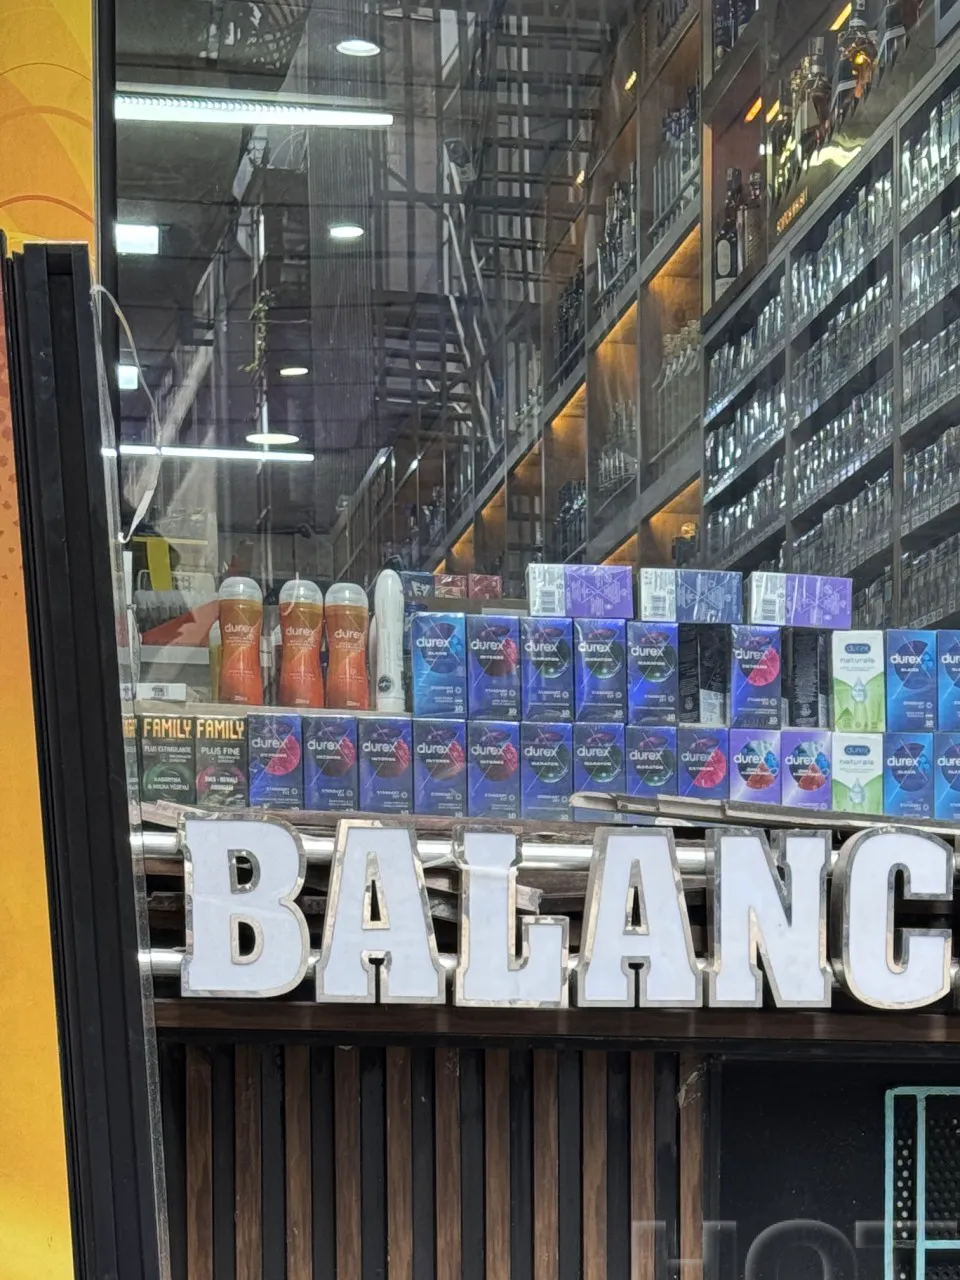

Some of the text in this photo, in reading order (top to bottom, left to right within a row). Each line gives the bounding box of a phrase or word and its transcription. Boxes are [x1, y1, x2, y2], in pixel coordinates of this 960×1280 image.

[224, 623, 256, 634] durex
[285, 625, 315, 636] durex
[334, 628, 365, 639] durex
[416, 636, 450, 648] durex
[471, 639, 505, 651] durex
[524, 640, 558, 652] durex
[577, 641, 611, 653] durex
[630, 645, 665, 657] durex
[734, 648, 768, 660] durex
[890, 653, 922, 665] durex
[143, 718, 192, 738] FAMILY
[196, 719, 245, 739] FAMILY
[251, 737, 289, 749] durex
[307, 739, 342, 751] durex
[362, 740, 398, 753] durex
[416, 742, 452, 754] durex
[200, 747, 241, 756] PLUS FINE
[471, 744, 505, 756] durex
[524, 745, 558, 757] durex
[576, 745, 611, 757] durex
[629, 749, 664, 761] durex
[681, 750, 716, 762] durex
[733, 752, 767, 764] durex
[784, 753, 818, 765] durex
[887, 755, 919, 767] durex
